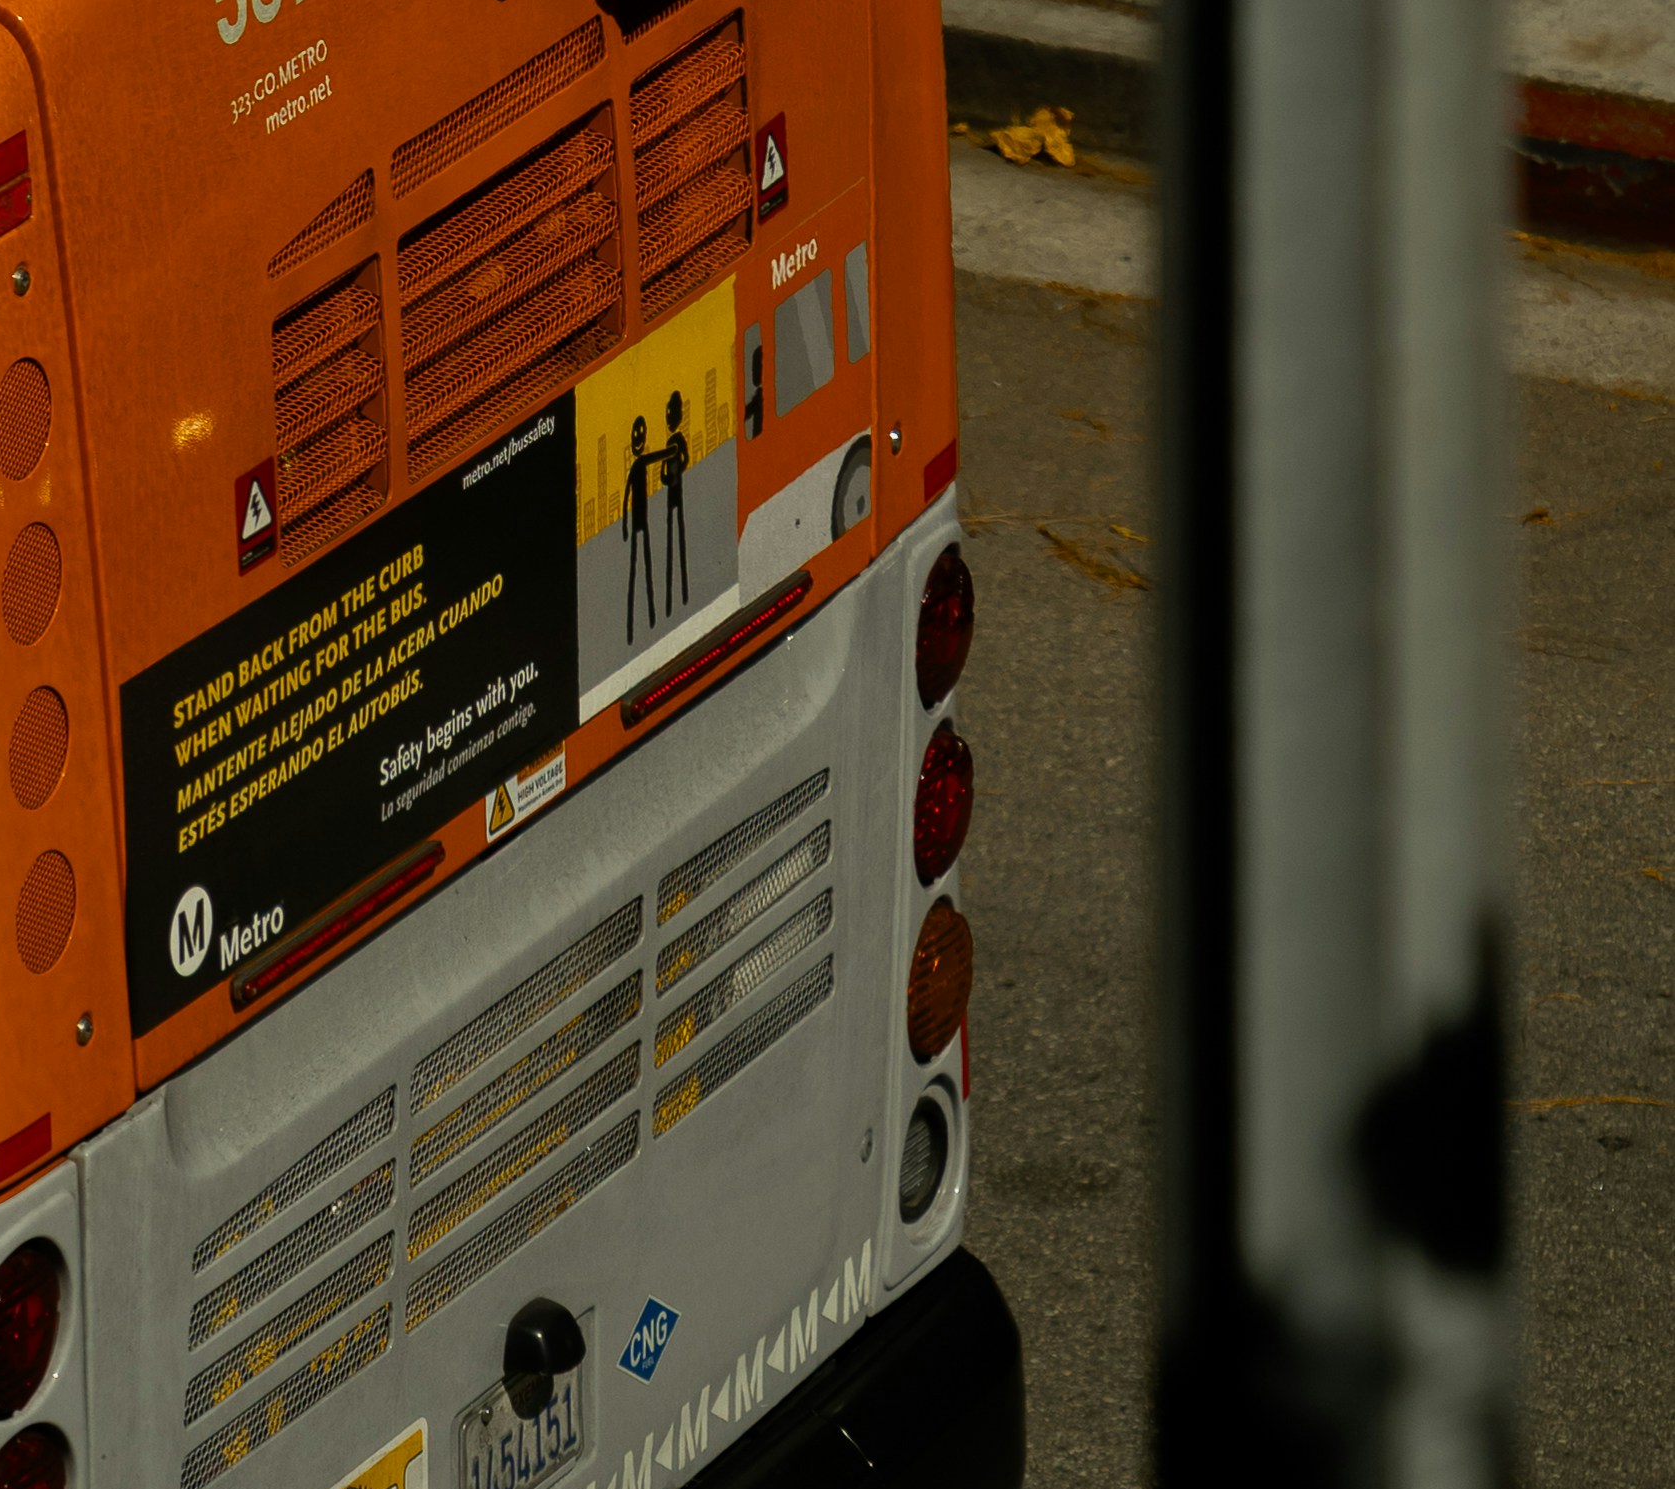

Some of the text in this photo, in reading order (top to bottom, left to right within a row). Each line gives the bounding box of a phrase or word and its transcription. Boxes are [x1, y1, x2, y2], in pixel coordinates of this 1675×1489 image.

[230, 39, 327, 124] 323.GO.METRO
[265, 75, 332, 134] metro.net
[771, 238, 818, 290] Metro
[462, 415, 555, 490] metro.net/bussafety
[172, 543, 424, 729] STAND BACK FROM THE CURB
[174, 581, 428, 768] WHEN WAITING FOR THE BUS.
[177, 573, 503, 814] MANTENTE ALEJADO DE LA ACERA CUANDO
[379, 661, 539, 786] Safety begins with you.
[178, 668, 424, 854] ESTÉS ESPERANDO EL AUTOBÚS.
[381, 802, 394, 823] La
[396, 759, 445, 811] seguridad
[447, 729, 495, 776] comienza
[496, 702, 537, 740] contigo.
[178, 898, 205, 966] M
[220, 906, 284, 971] Metro
[630, 1310, 667, 1367] CNG
